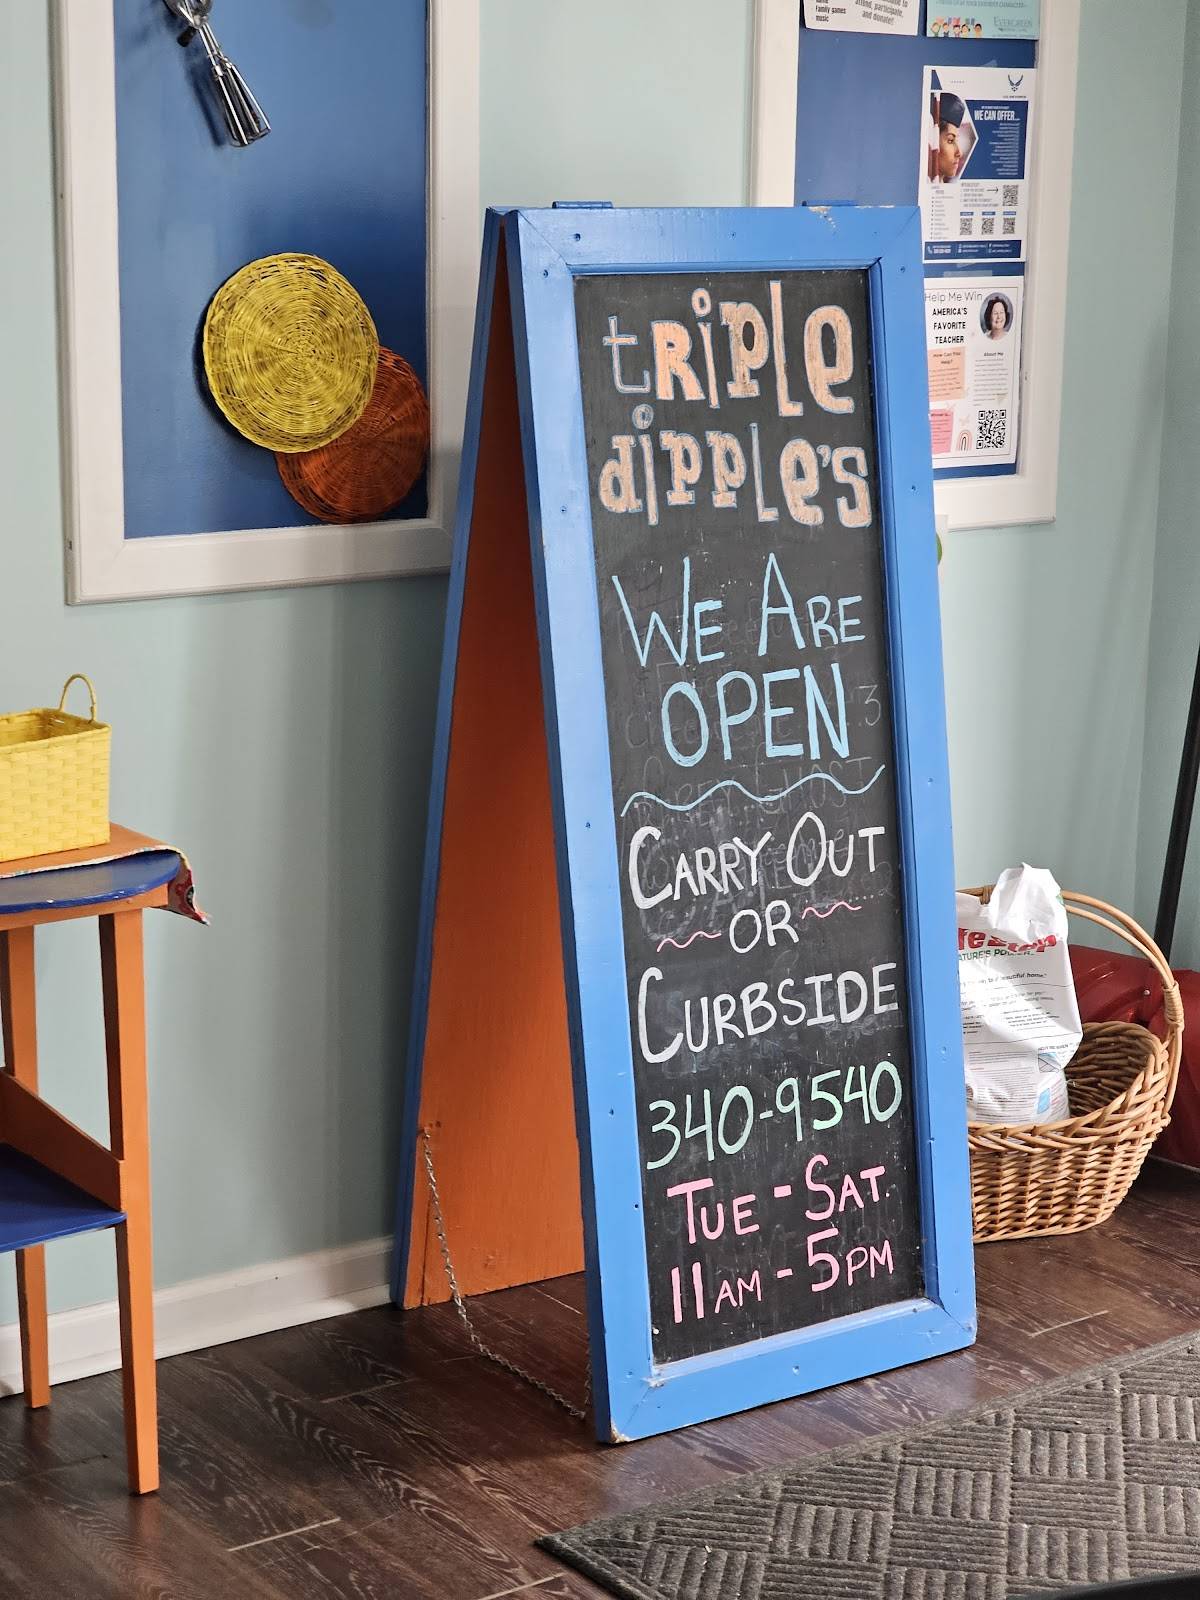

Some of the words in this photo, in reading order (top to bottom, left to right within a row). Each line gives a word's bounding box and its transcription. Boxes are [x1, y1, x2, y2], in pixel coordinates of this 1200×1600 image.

[815, 14, 829, 22] music
[974, 110, 984, 120] WE
[984, 110, 997, 120] CAN
[932, 307, 968, 316] AMERICA'S
[948, 292, 962, 302] Me
[964, 291, 983, 301] Win
[933, 322, 966, 330] FAVORITE
[935, 336, 965, 344] TEACHER
[611, 555, 725, 668] WE
[757, 552, 866, 657] ARE
[660, 662, 850, 768] OPEN
[628, 825, 773, 910] CARRY
[786, 811, 886, 887] OUT
[728, 899, 800, 954] OR
[959, 948, 991, 960] ATURE'S
[637, 962, 899, 1064] CURBSIDE
[646, 1060, 903, 1170] 340-9540
[666, 1177, 761, 1245] TUE
